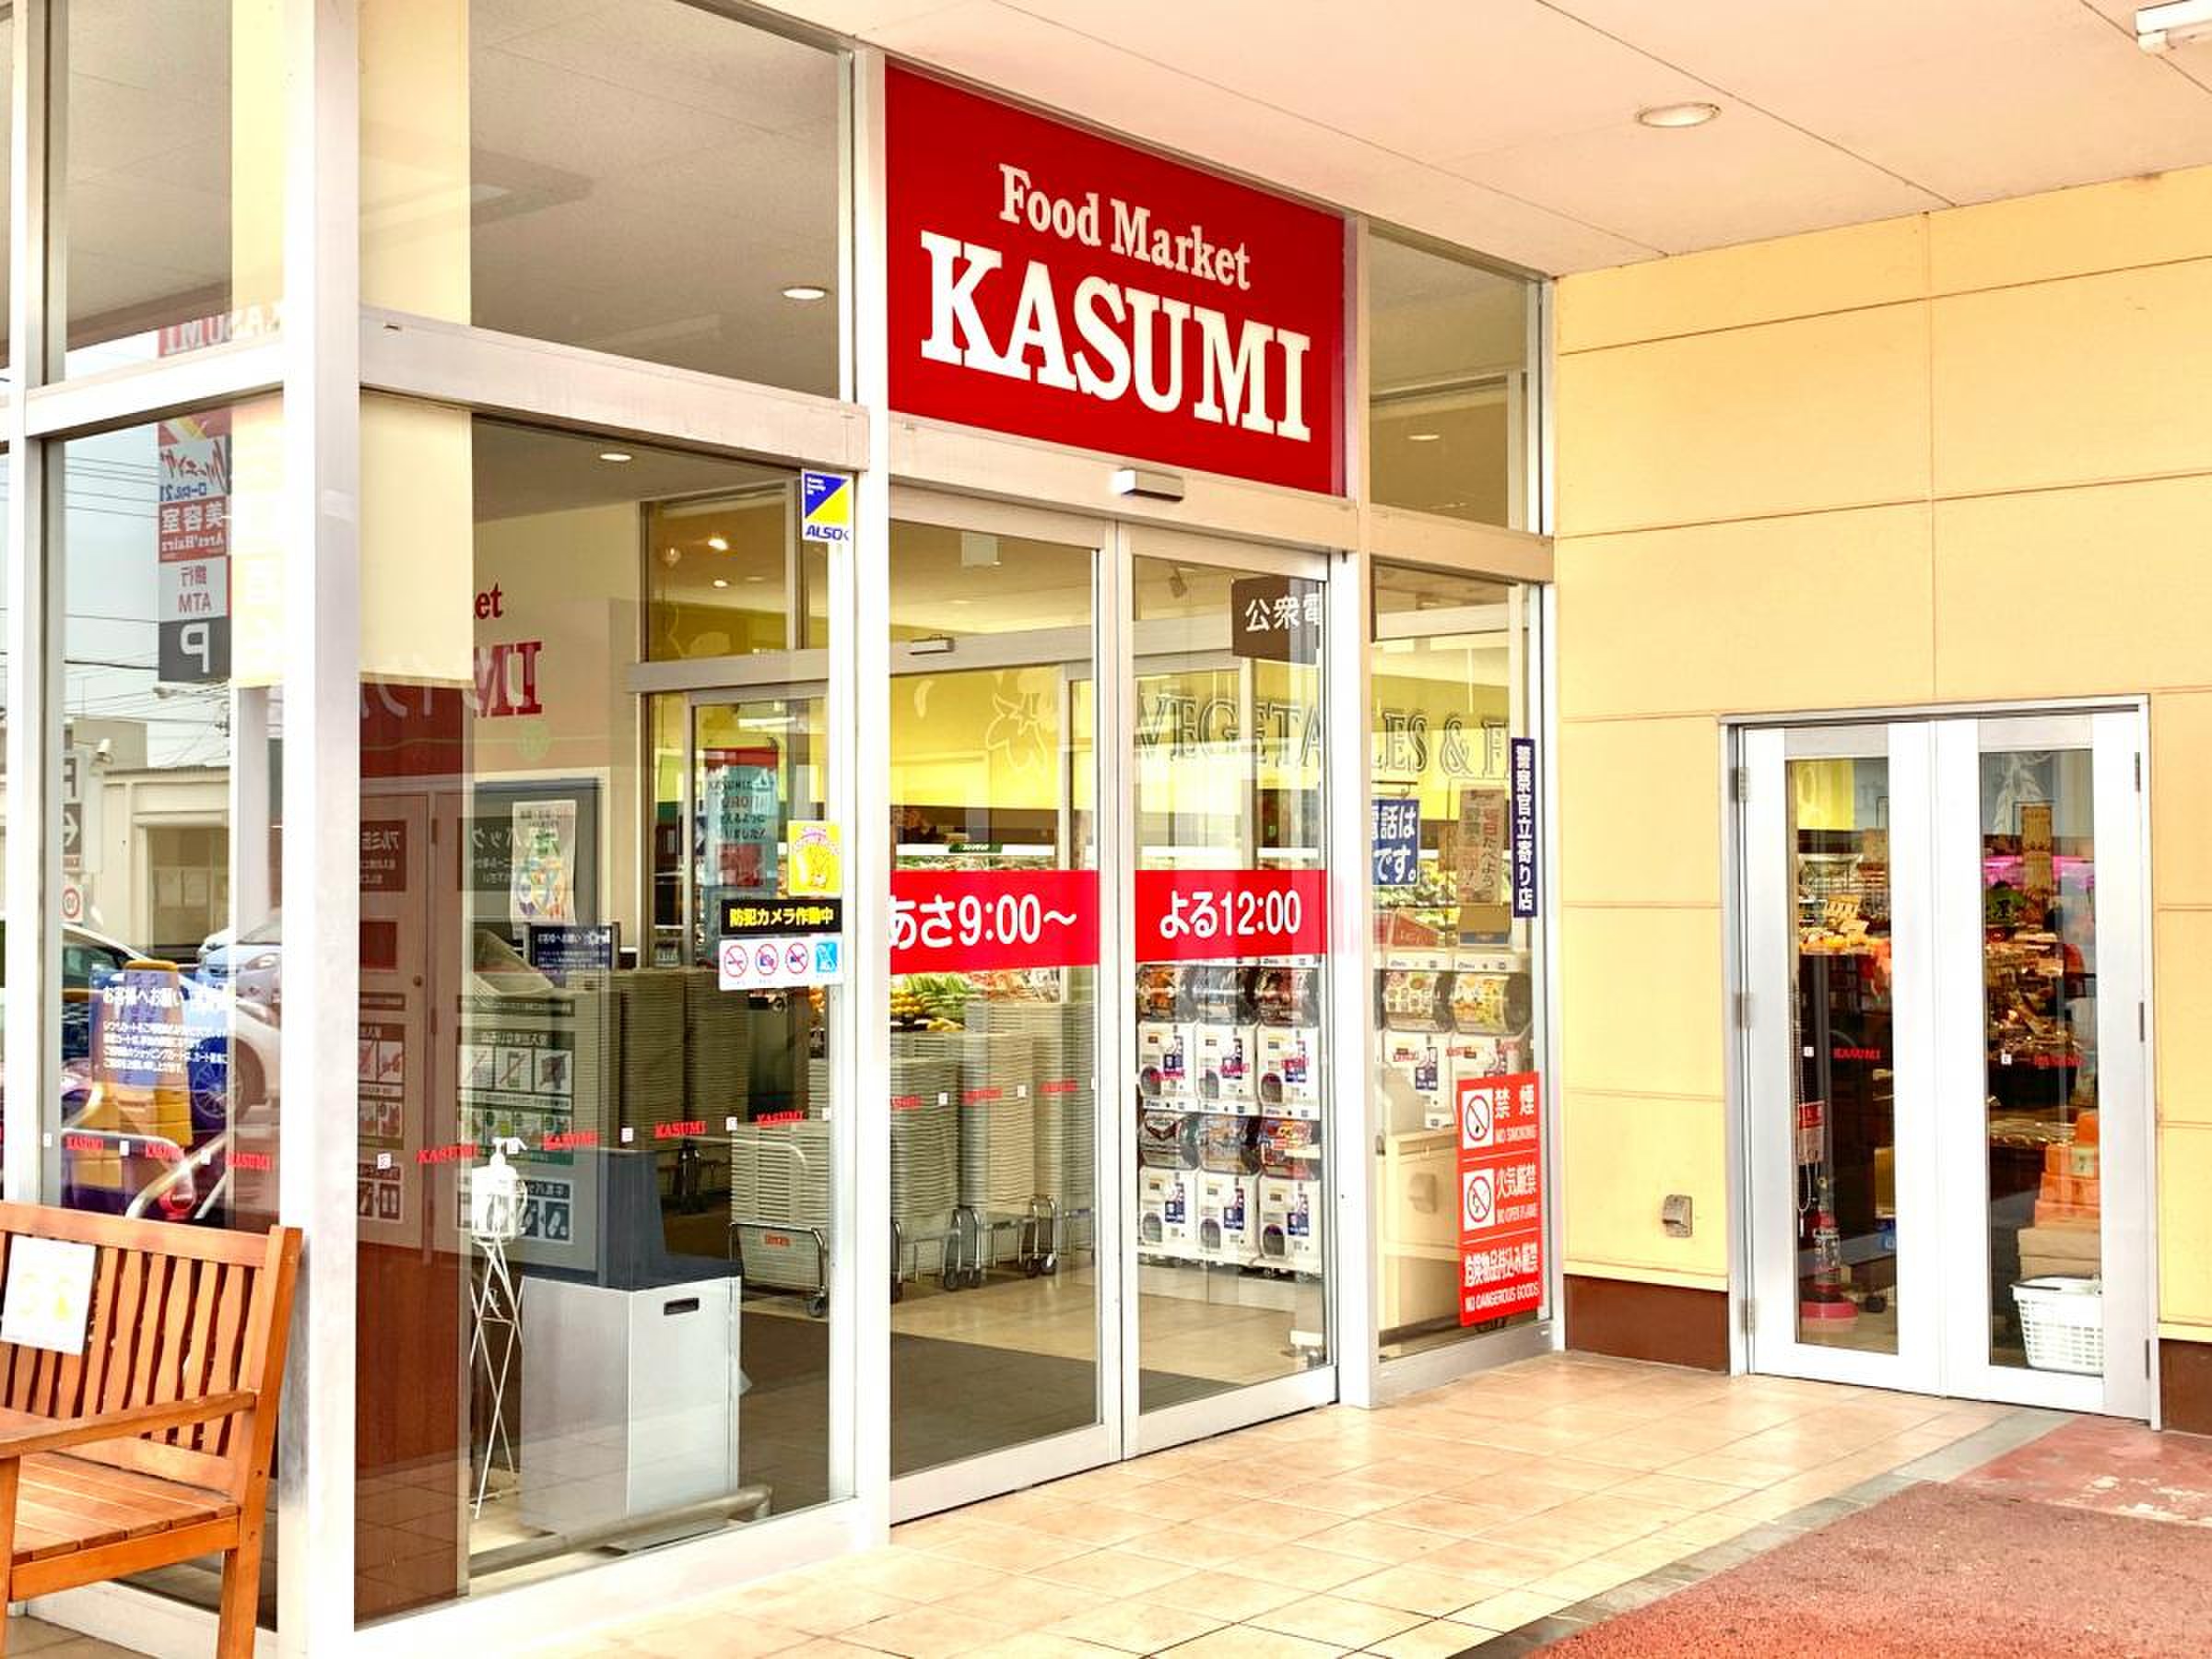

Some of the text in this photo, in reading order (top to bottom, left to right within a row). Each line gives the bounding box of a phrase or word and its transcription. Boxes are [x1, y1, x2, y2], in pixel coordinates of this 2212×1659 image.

[999, 162, 1252, 291] Food Market
[920, 229, 1312, 443] KASUMI
[729, 906, 835, 928] 防犯カメラ作動中
[1159, 888, 1301, 940] よる12:00
[1495, 1083, 1535, 1119] 禁煙
